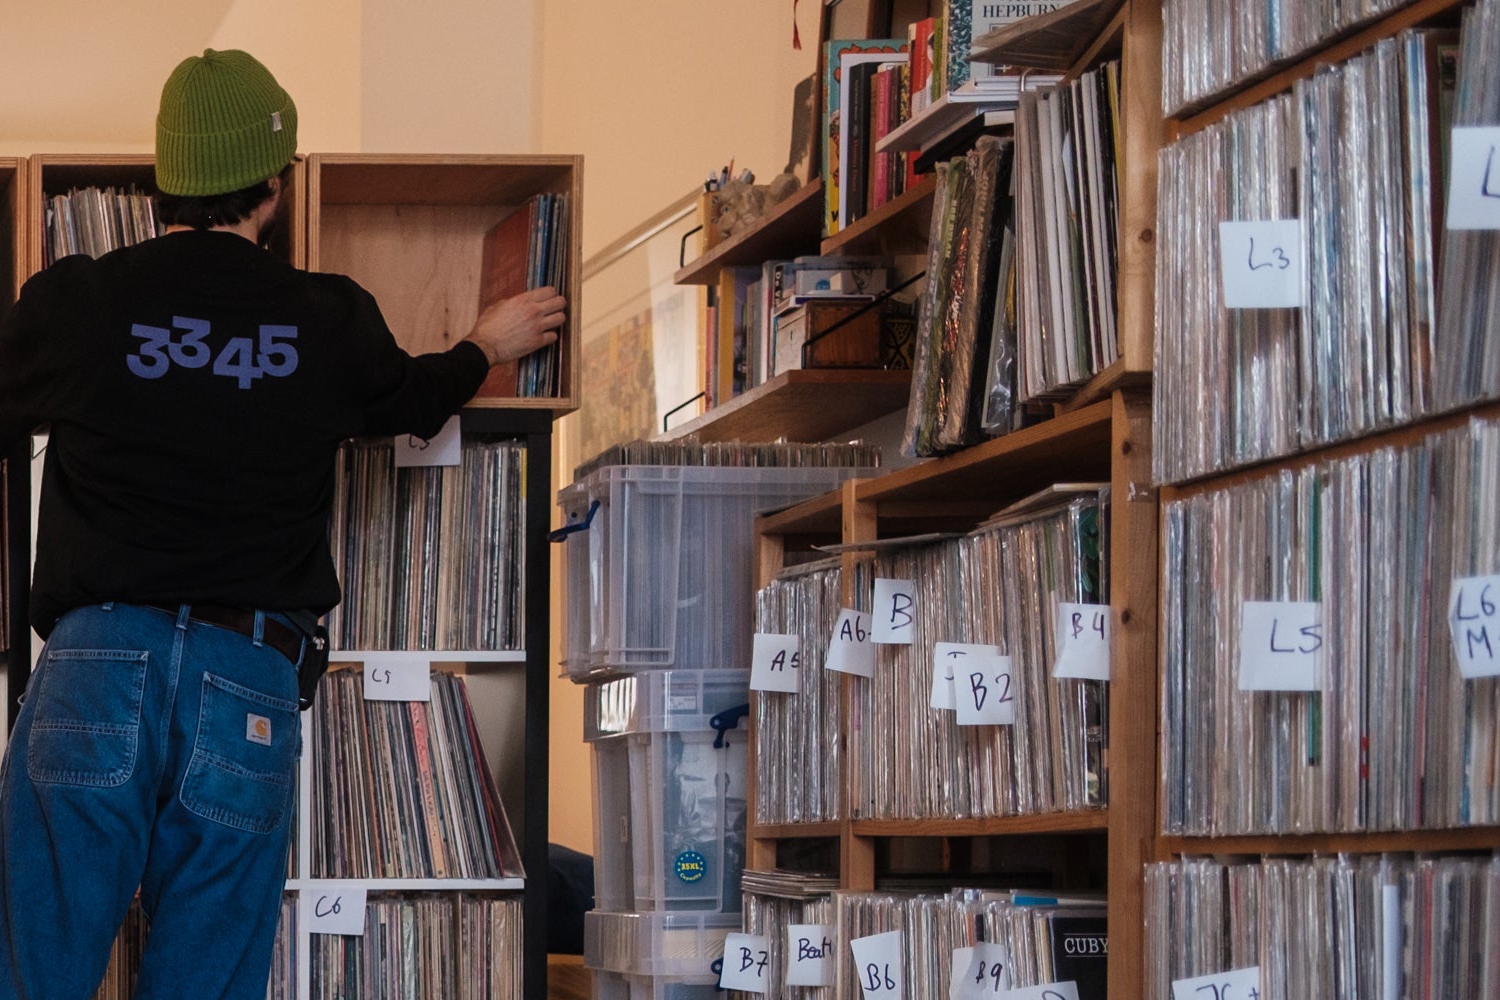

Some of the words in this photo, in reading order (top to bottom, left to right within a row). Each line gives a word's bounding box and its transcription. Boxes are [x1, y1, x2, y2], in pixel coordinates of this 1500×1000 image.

[983, 3, 1060, 18] HEPBURN
[1248, 237, 1290, 271] L3
[1457, 583, 1496, 620] L6
[1269, 618, 1323, 653] L5
[314, 895, 342, 918] C6
[1064, 937, 1109, 954] CUBY
[739, 946, 768, 978] B7
[864, 963, 896, 991] B6
